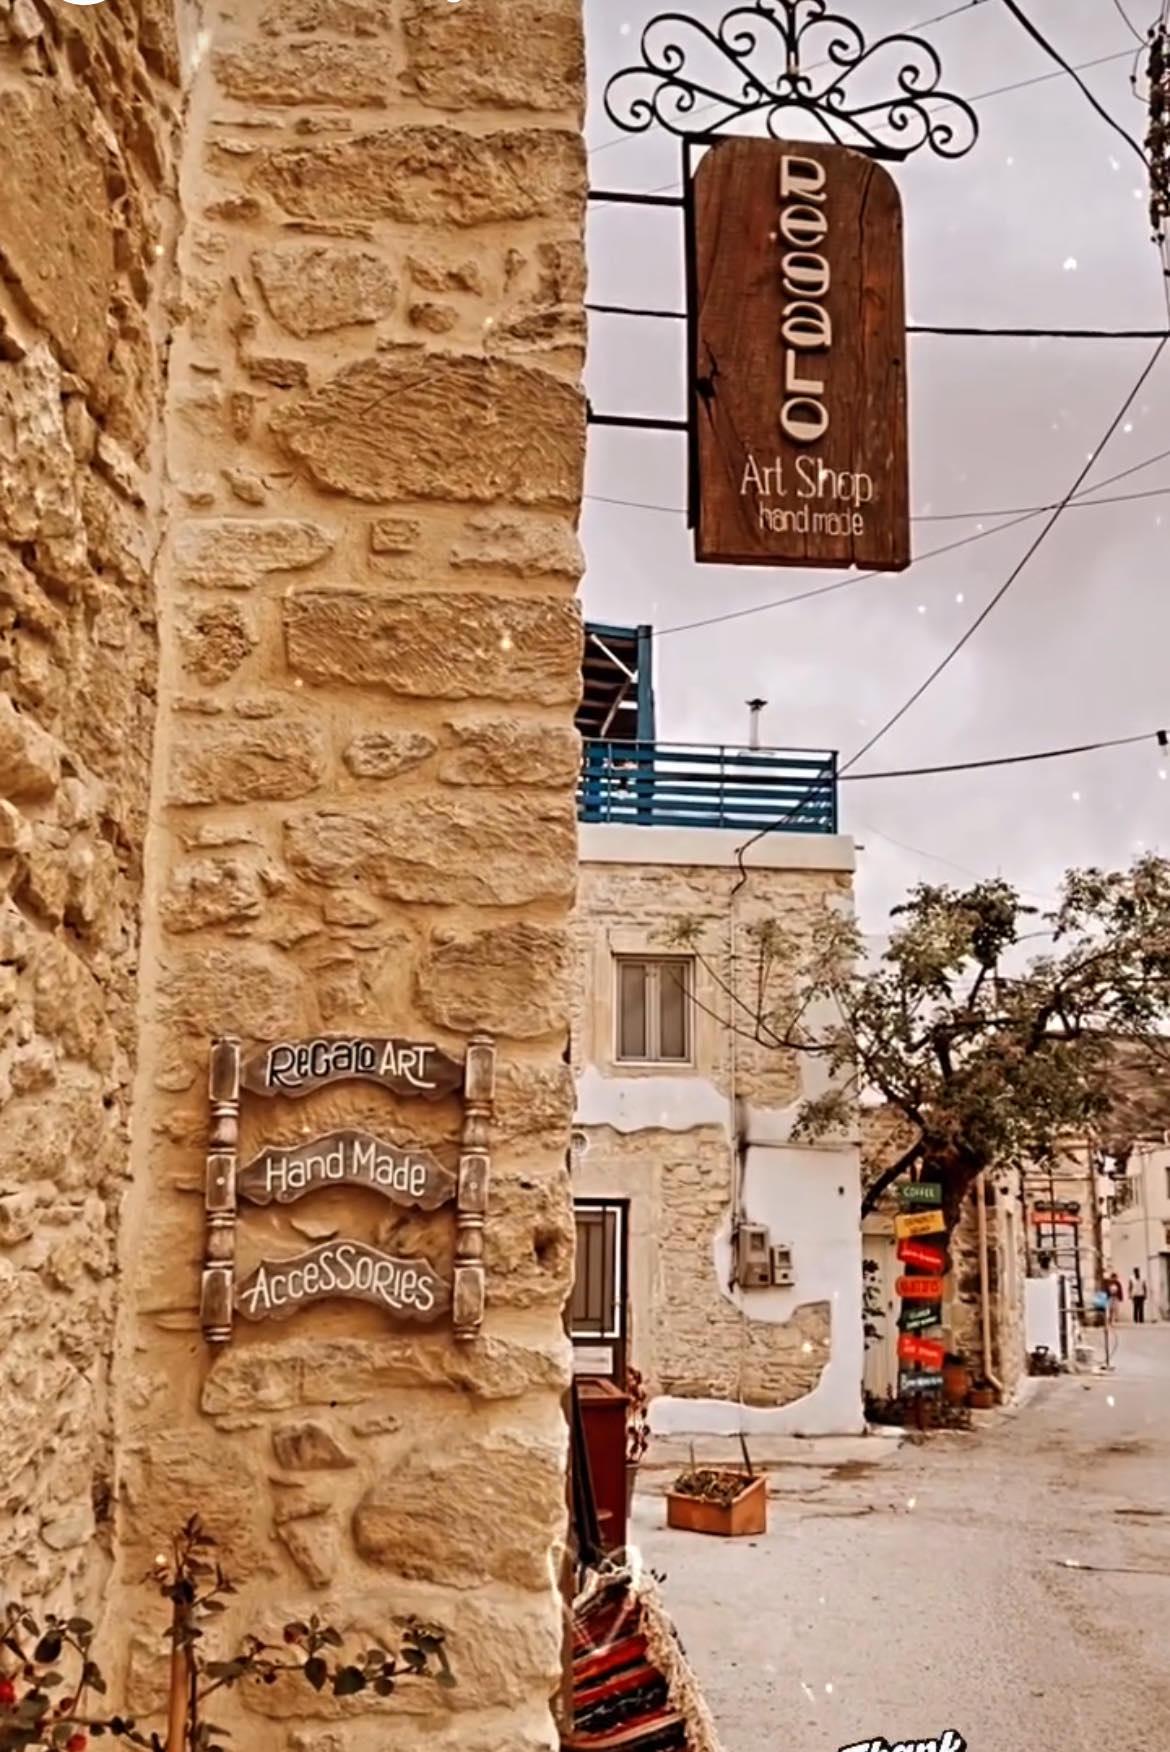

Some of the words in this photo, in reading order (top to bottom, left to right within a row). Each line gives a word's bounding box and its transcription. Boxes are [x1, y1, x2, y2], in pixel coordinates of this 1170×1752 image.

[740, 453, 788, 497] Art
[795, 455, 873, 508] Shop
[379, 1040, 437, 1089] ART
[266, 1141, 345, 1192] Hand
[352, 1140, 426, 1197] Made
